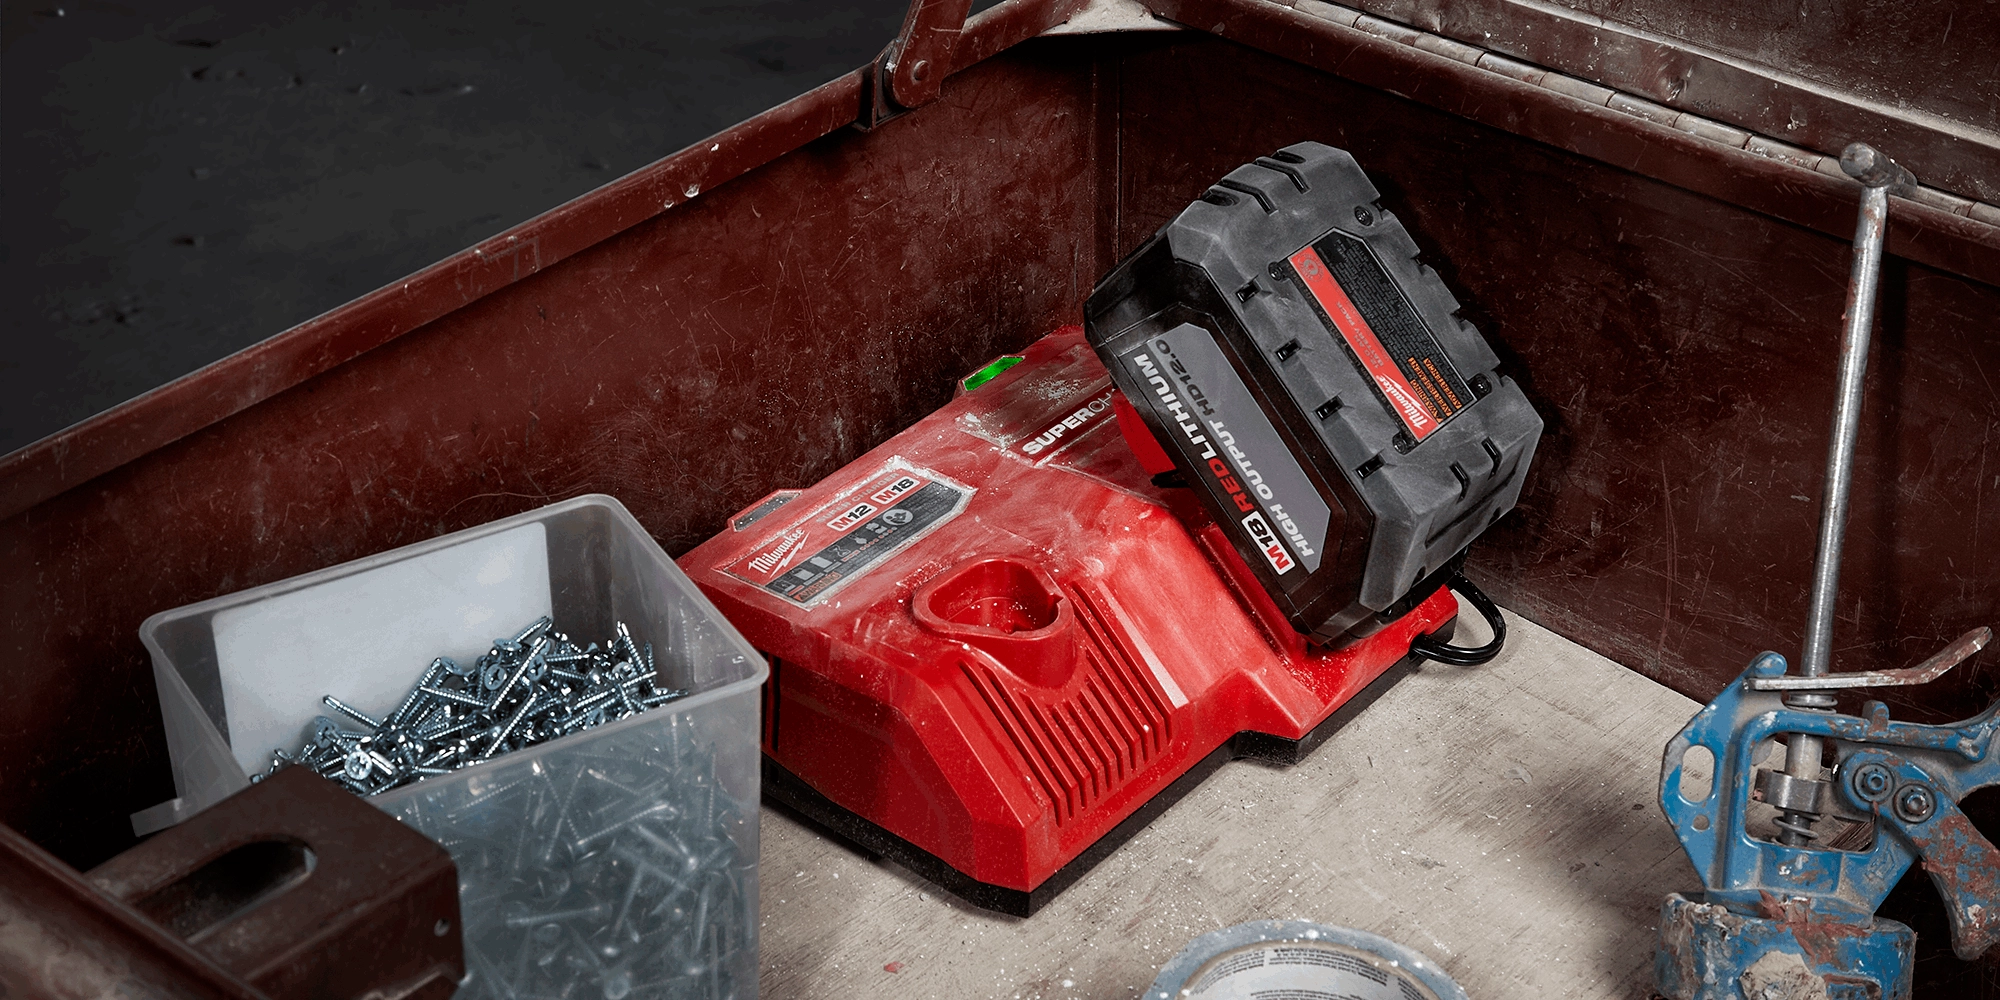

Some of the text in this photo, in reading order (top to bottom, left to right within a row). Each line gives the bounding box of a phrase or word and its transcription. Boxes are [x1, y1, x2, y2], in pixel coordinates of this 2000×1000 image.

[1335, 300, 1384, 366] BATTERY PACK
[1377, 373, 1427, 430] Milwaukee
[1407, 357, 1451, 414] AVERTISSEMENT
[1410, 379, 1437, 414] WARNING
[1423, 358, 1461, 407] ADVERTENCIA
[1133, 353, 1290, 570] M18 REDLITHIUM
[1154, 339, 1314, 555] HIGH OUTPUT HD12.0
[832, 504, 872, 529] M12
[876, 478, 914, 502] M18
[852, 472, 900, 502] CHARGER
[748, 529, 805, 574] Milwaukee
